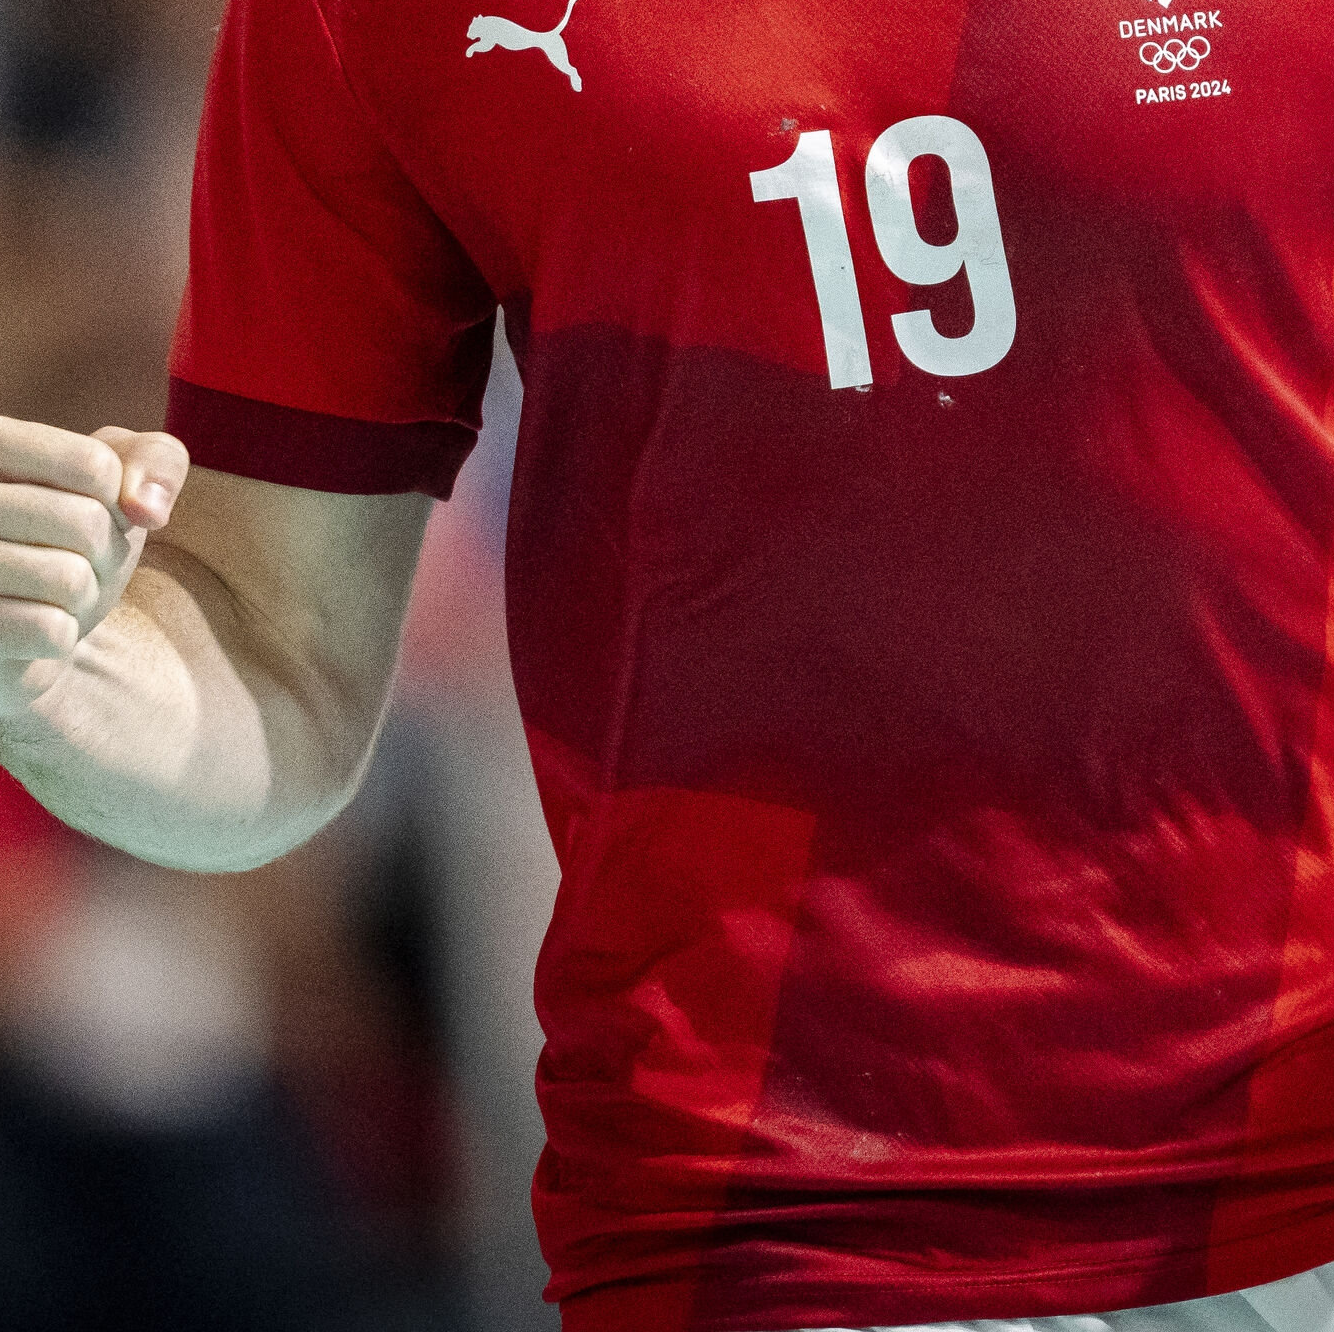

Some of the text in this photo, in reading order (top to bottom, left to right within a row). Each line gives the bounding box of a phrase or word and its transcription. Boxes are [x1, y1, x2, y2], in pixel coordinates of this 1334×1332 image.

[1118, 9, 1223, 39] DENMARK
[1135, 79, 1232, 105] PARIS 2024
[749, 115, 1017, 390] 19
